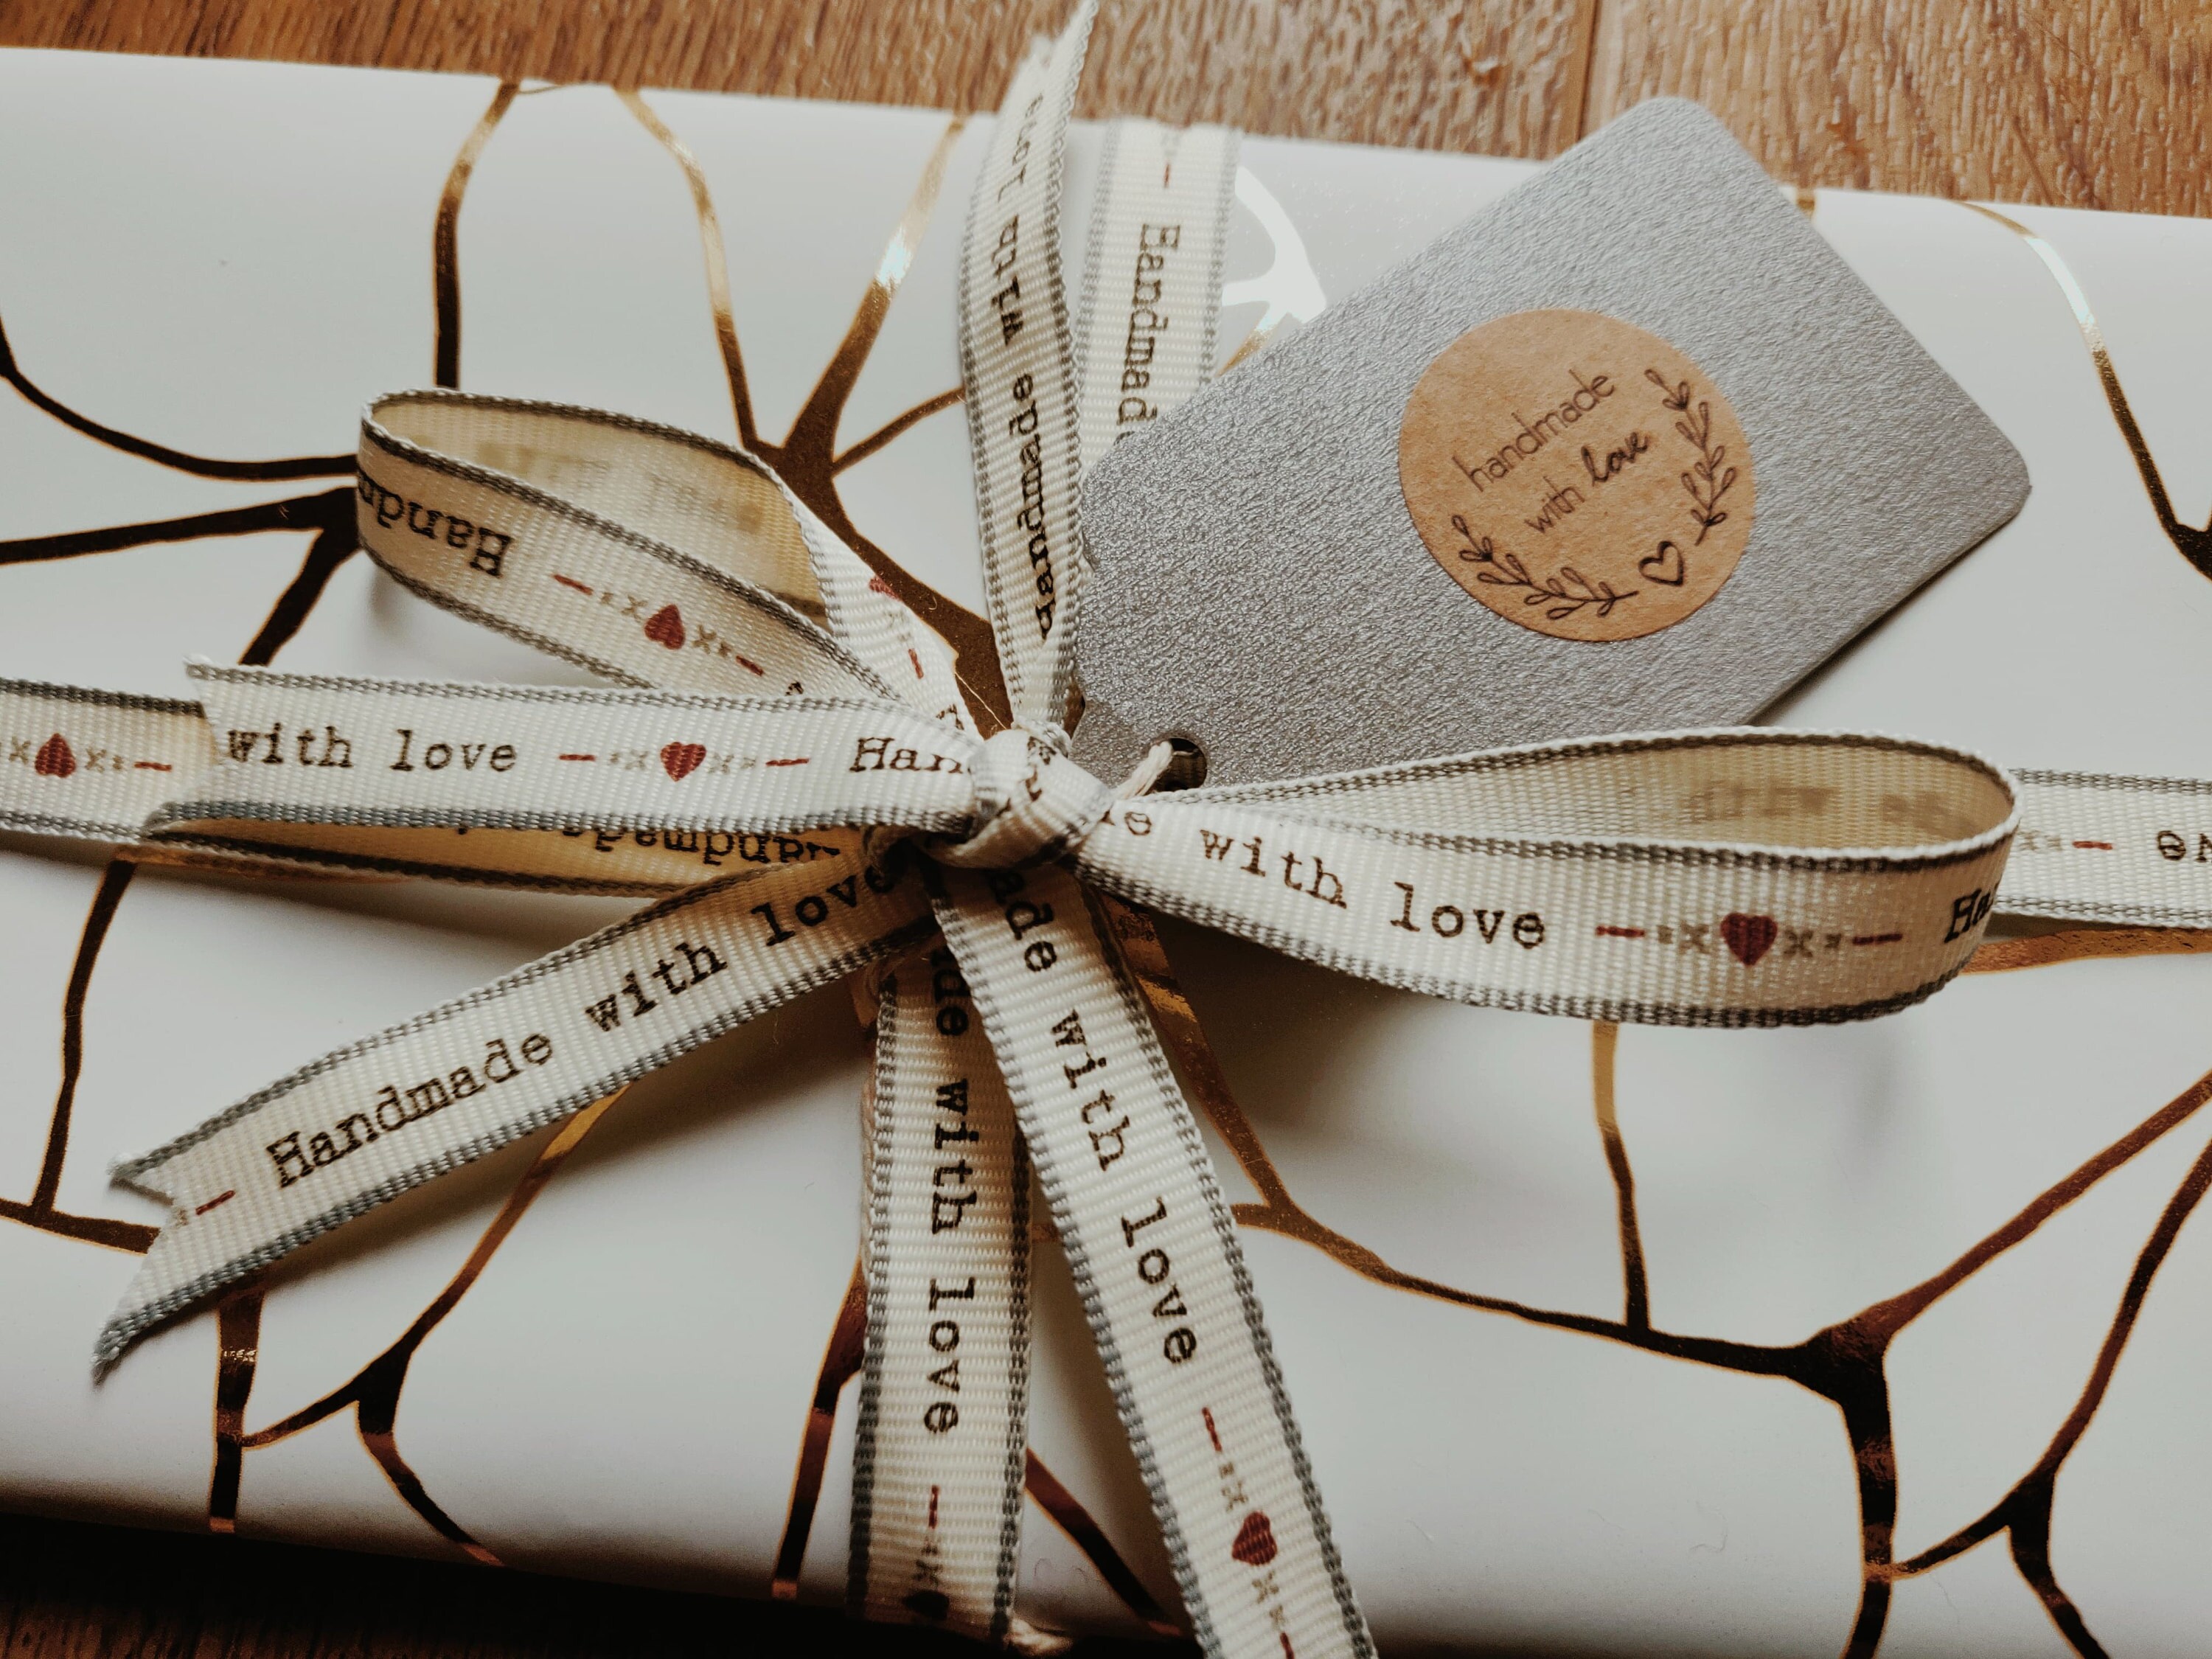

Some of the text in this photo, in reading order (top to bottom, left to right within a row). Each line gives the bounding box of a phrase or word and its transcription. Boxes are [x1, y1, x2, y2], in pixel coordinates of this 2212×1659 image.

[1114, 223, 1180, 445] Handmad
[1452, 369, 1615, 492] handmade
[1524, 432, 1650, 534] with love
[227, 722, 516, 772] with love
[849, 737, 971, 774] Han
[1200, 829, 1347, 910] with
[1391, 881, 1545, 949] love
[265, 866, 894, 1189] Handmade with love
[932, 1078, 980, 1235] with
[1051, 1009, 1130, 1172] with
[1120, 1196, 1198, 1366] love
[923, 1276, 977, 1434] love
